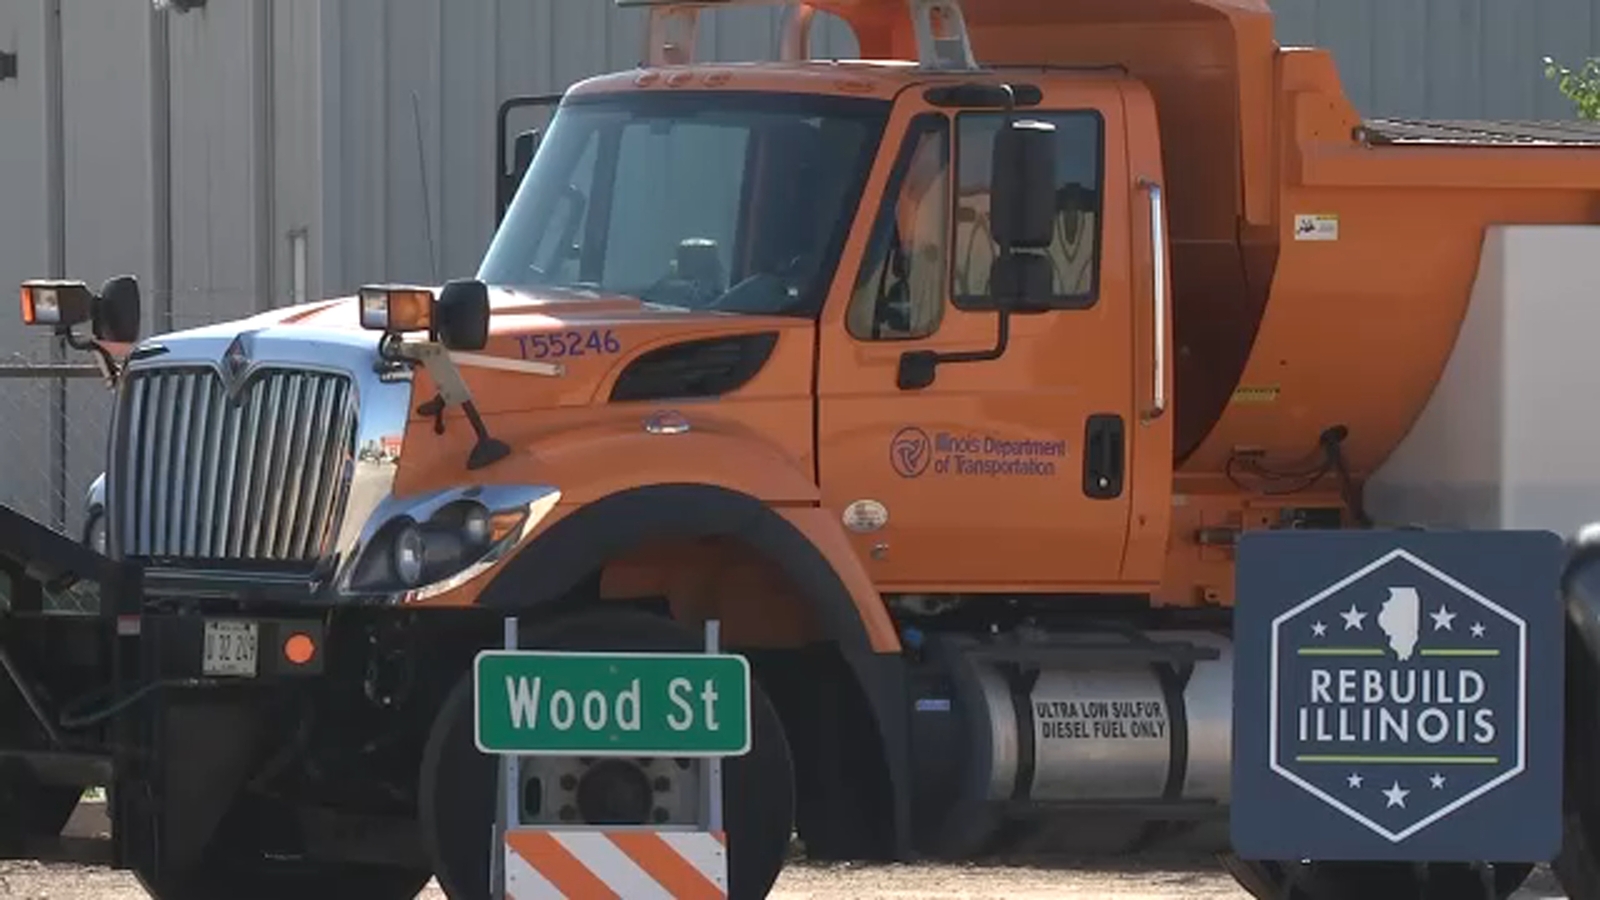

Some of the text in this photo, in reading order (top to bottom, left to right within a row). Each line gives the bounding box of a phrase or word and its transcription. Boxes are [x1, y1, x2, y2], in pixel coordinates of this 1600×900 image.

[514, 329, 620, 360] T55246
[984, 436, 1066, 458] Department
[934, 455, 1055, 476] of Transportation
[1311, 669, 1486, 704] REBUILD
[505, 675, 720, 731] Wood St
[1036, 702, 1163, 718] ULTRA LOW SULFUR
[1042, 721, 1166, 738] DIESEL FUEL ONLY
[1299, 707, 1496, 744] ILLINOIS
